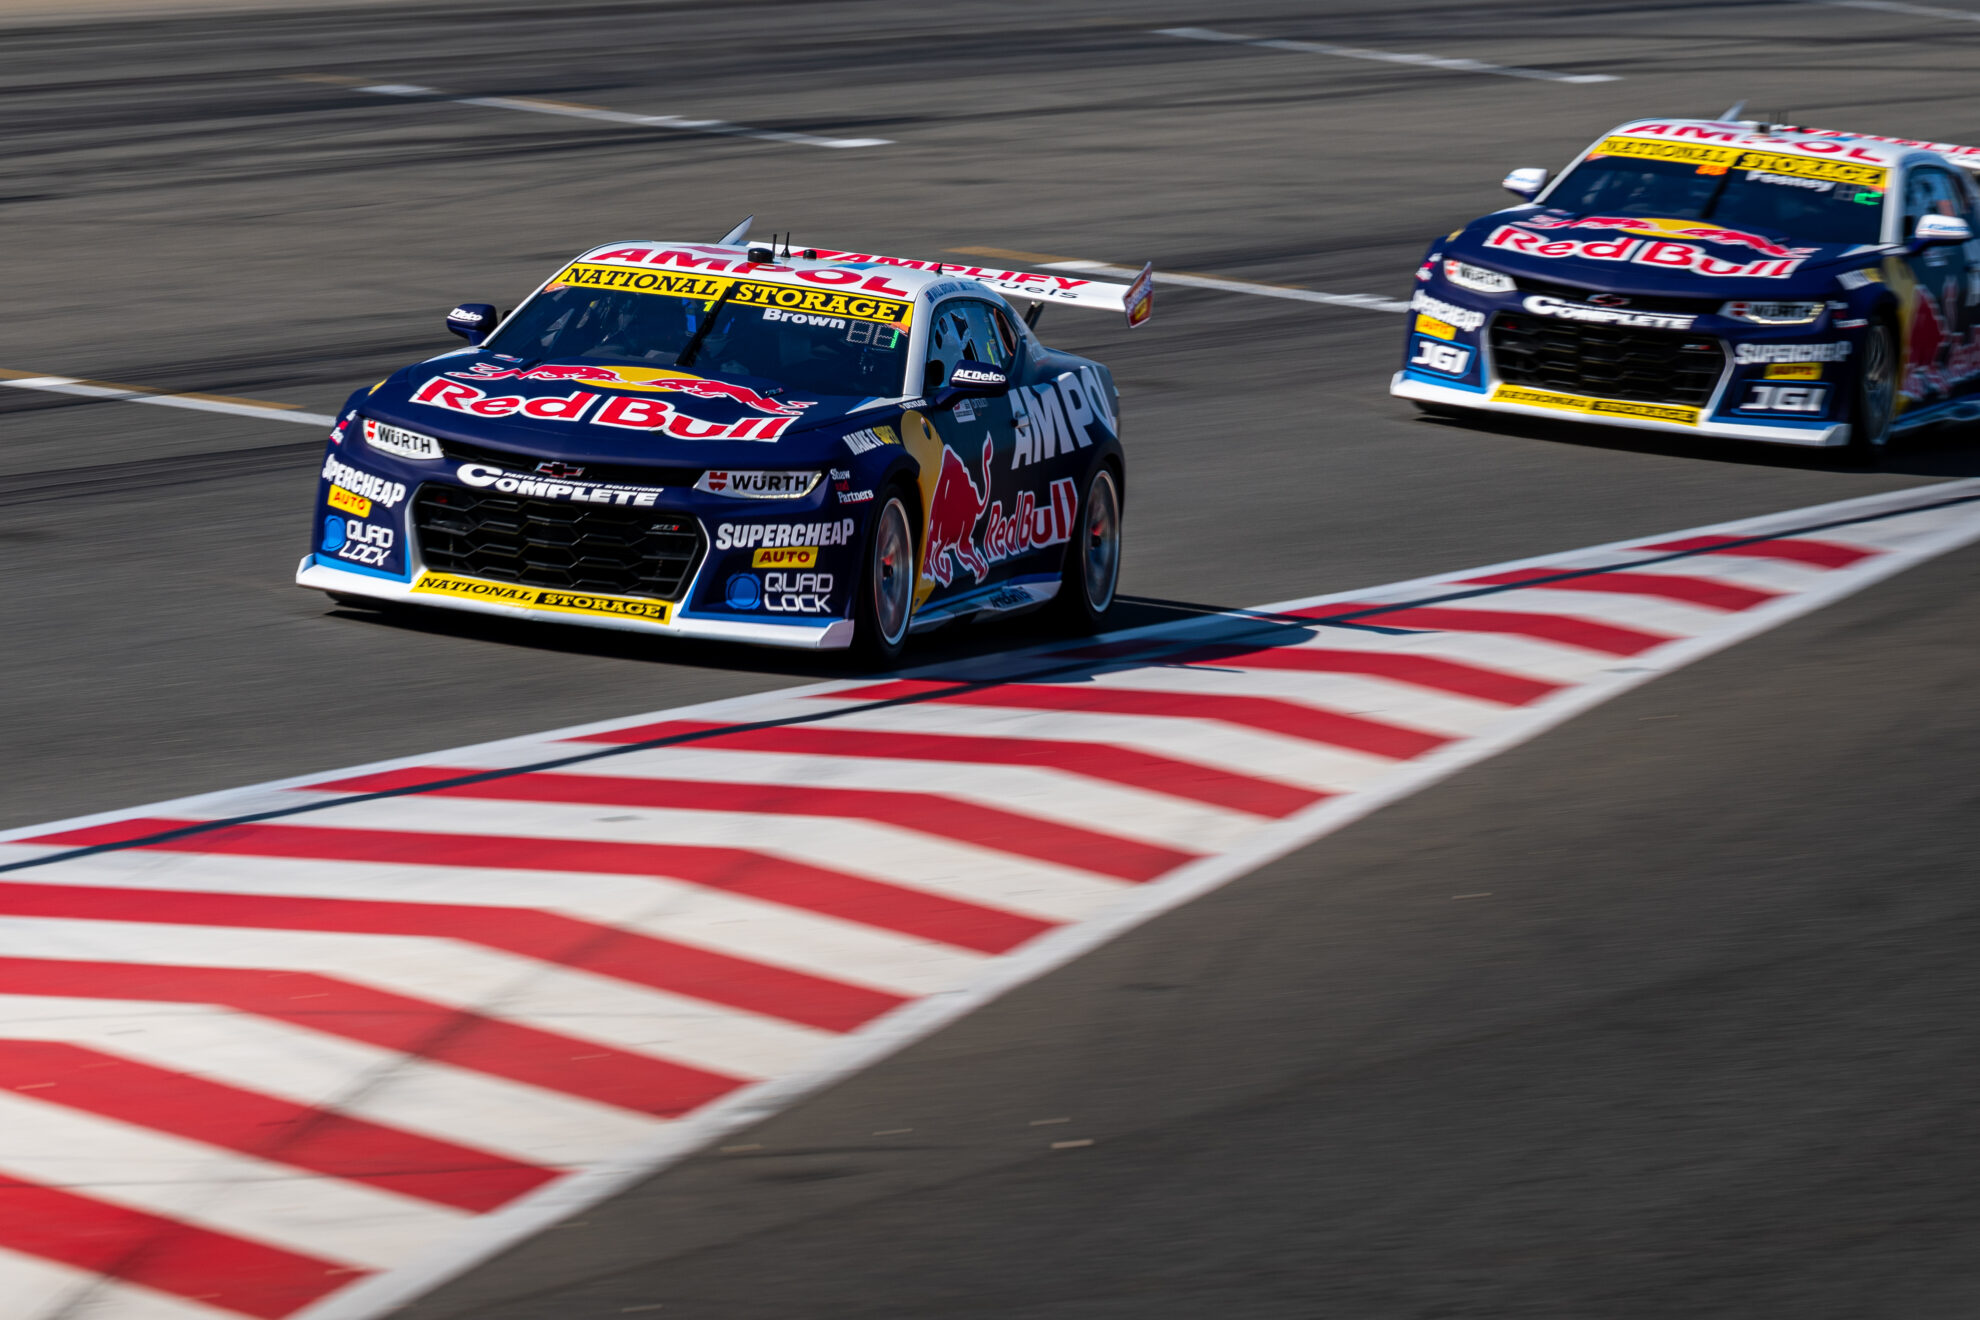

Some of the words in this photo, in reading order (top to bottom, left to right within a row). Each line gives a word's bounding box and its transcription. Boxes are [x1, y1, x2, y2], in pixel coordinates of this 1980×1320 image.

[590, 248, 908, 298] AMPOL
[834, 253, 1091, 290] AMPLIFY
[562, 268, 719, 297] NATIONAL
[735, 284, 900, 323] STORAGE
[762, 308, 846, 330] Brown
[954, 368, 1007, 382] ACDelco
[408, 376, 602, 421] Red
[590, 396, 801, 443] Bull
[456, 463, 661, 507] COMPLETE
[732, 475, 808, 491] WÜRTH
[715, 518, 855, 550] SUPERCHEAP
[338, 541, 391, 567] LOCK
[759, 551, 811, 563] AUTO
[764, 572, 834, 593] QUAD
[419, 577, 534, 600] NATIONAL
[543, 592, 663, 619] STORAGE
[764, 594, 832, 613] LOCK
